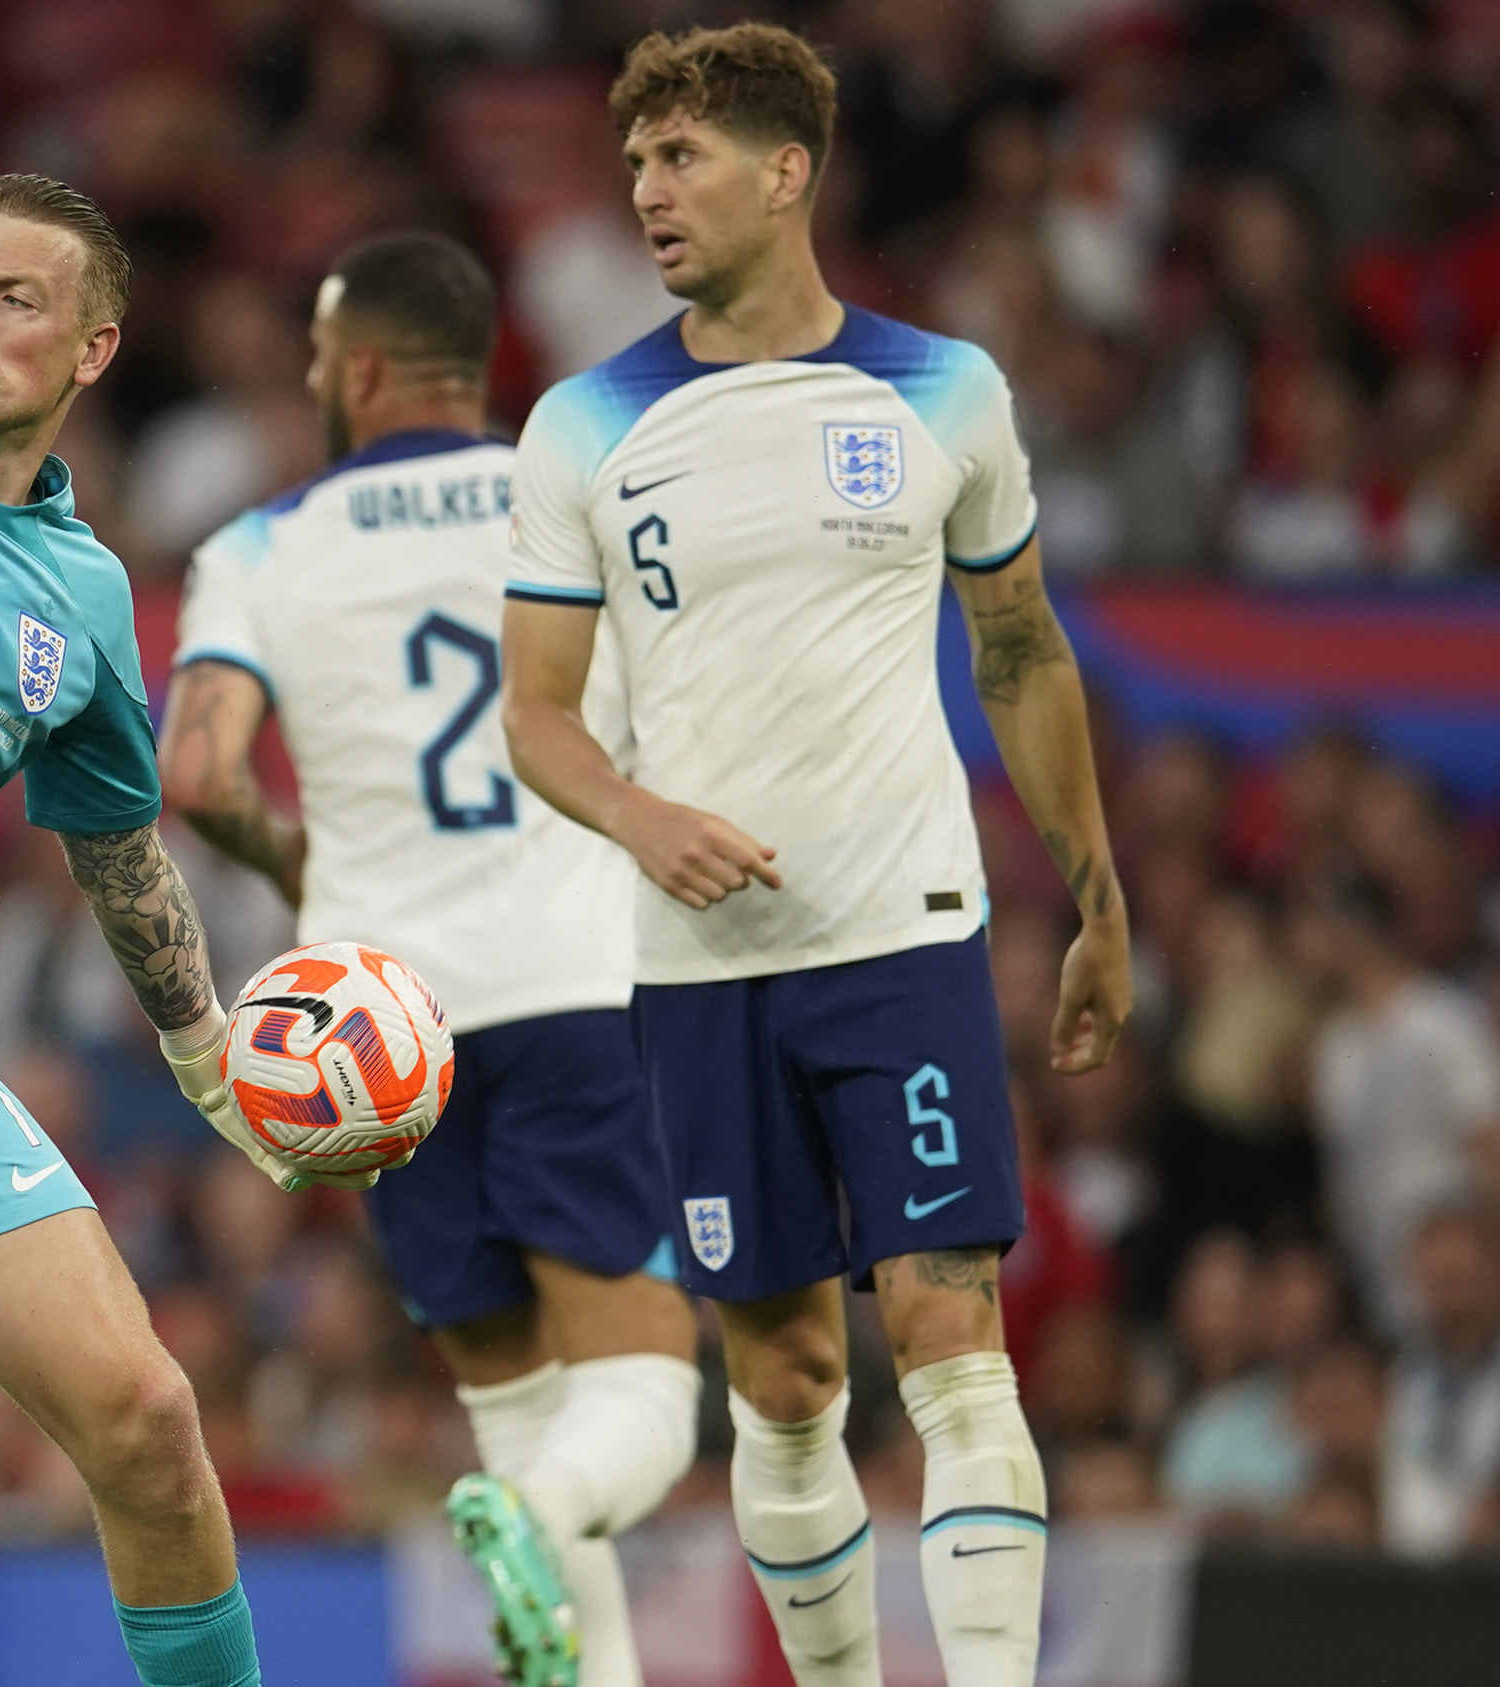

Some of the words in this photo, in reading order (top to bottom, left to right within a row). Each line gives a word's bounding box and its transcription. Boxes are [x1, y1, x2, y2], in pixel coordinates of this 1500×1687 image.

[349, 475, 512, 531] WALKER
[628, 513, 679, 611] 5
[407, 608, 517, 832] 2
[333, 1059, 357, 1100] FLIGHT
[903, 1063, 960, 1168] 5
